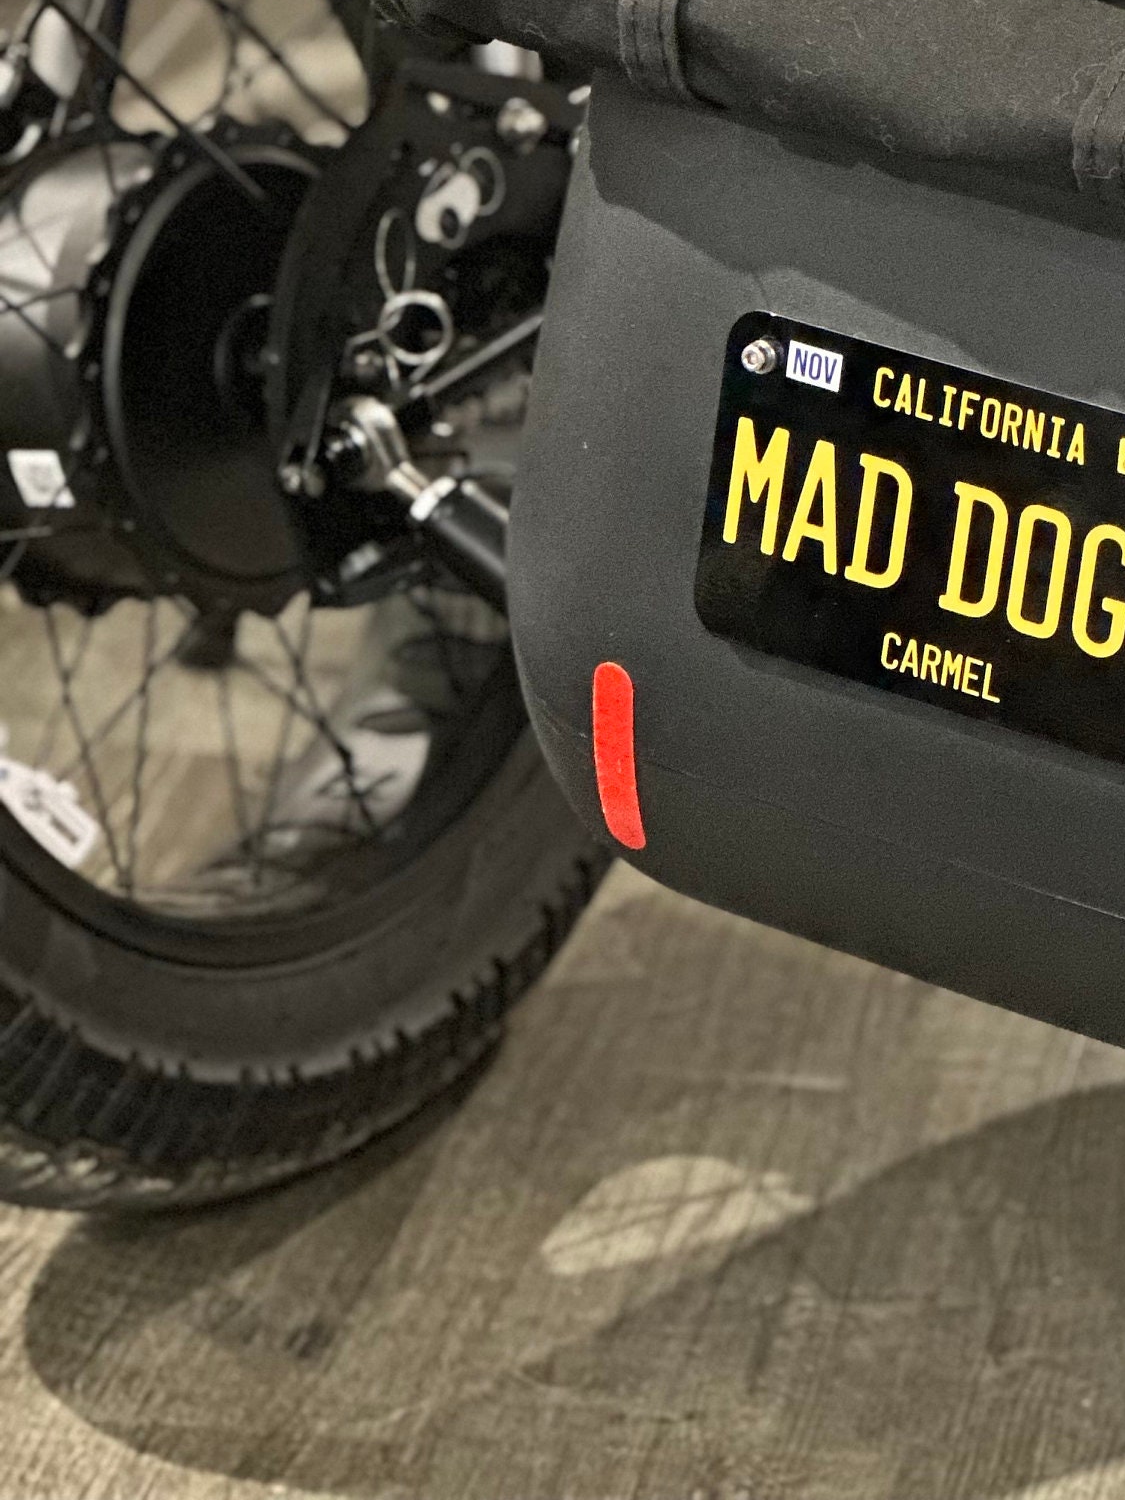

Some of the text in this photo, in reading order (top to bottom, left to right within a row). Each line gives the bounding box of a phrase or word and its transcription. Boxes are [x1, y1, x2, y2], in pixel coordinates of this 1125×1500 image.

[793, 348, 837, 384] NOV
[872, 366, 1086, 466] CALIFORNIA
[722, 416, 913, 589] MAD
[881, 632, 1000, 703] CARMEL
